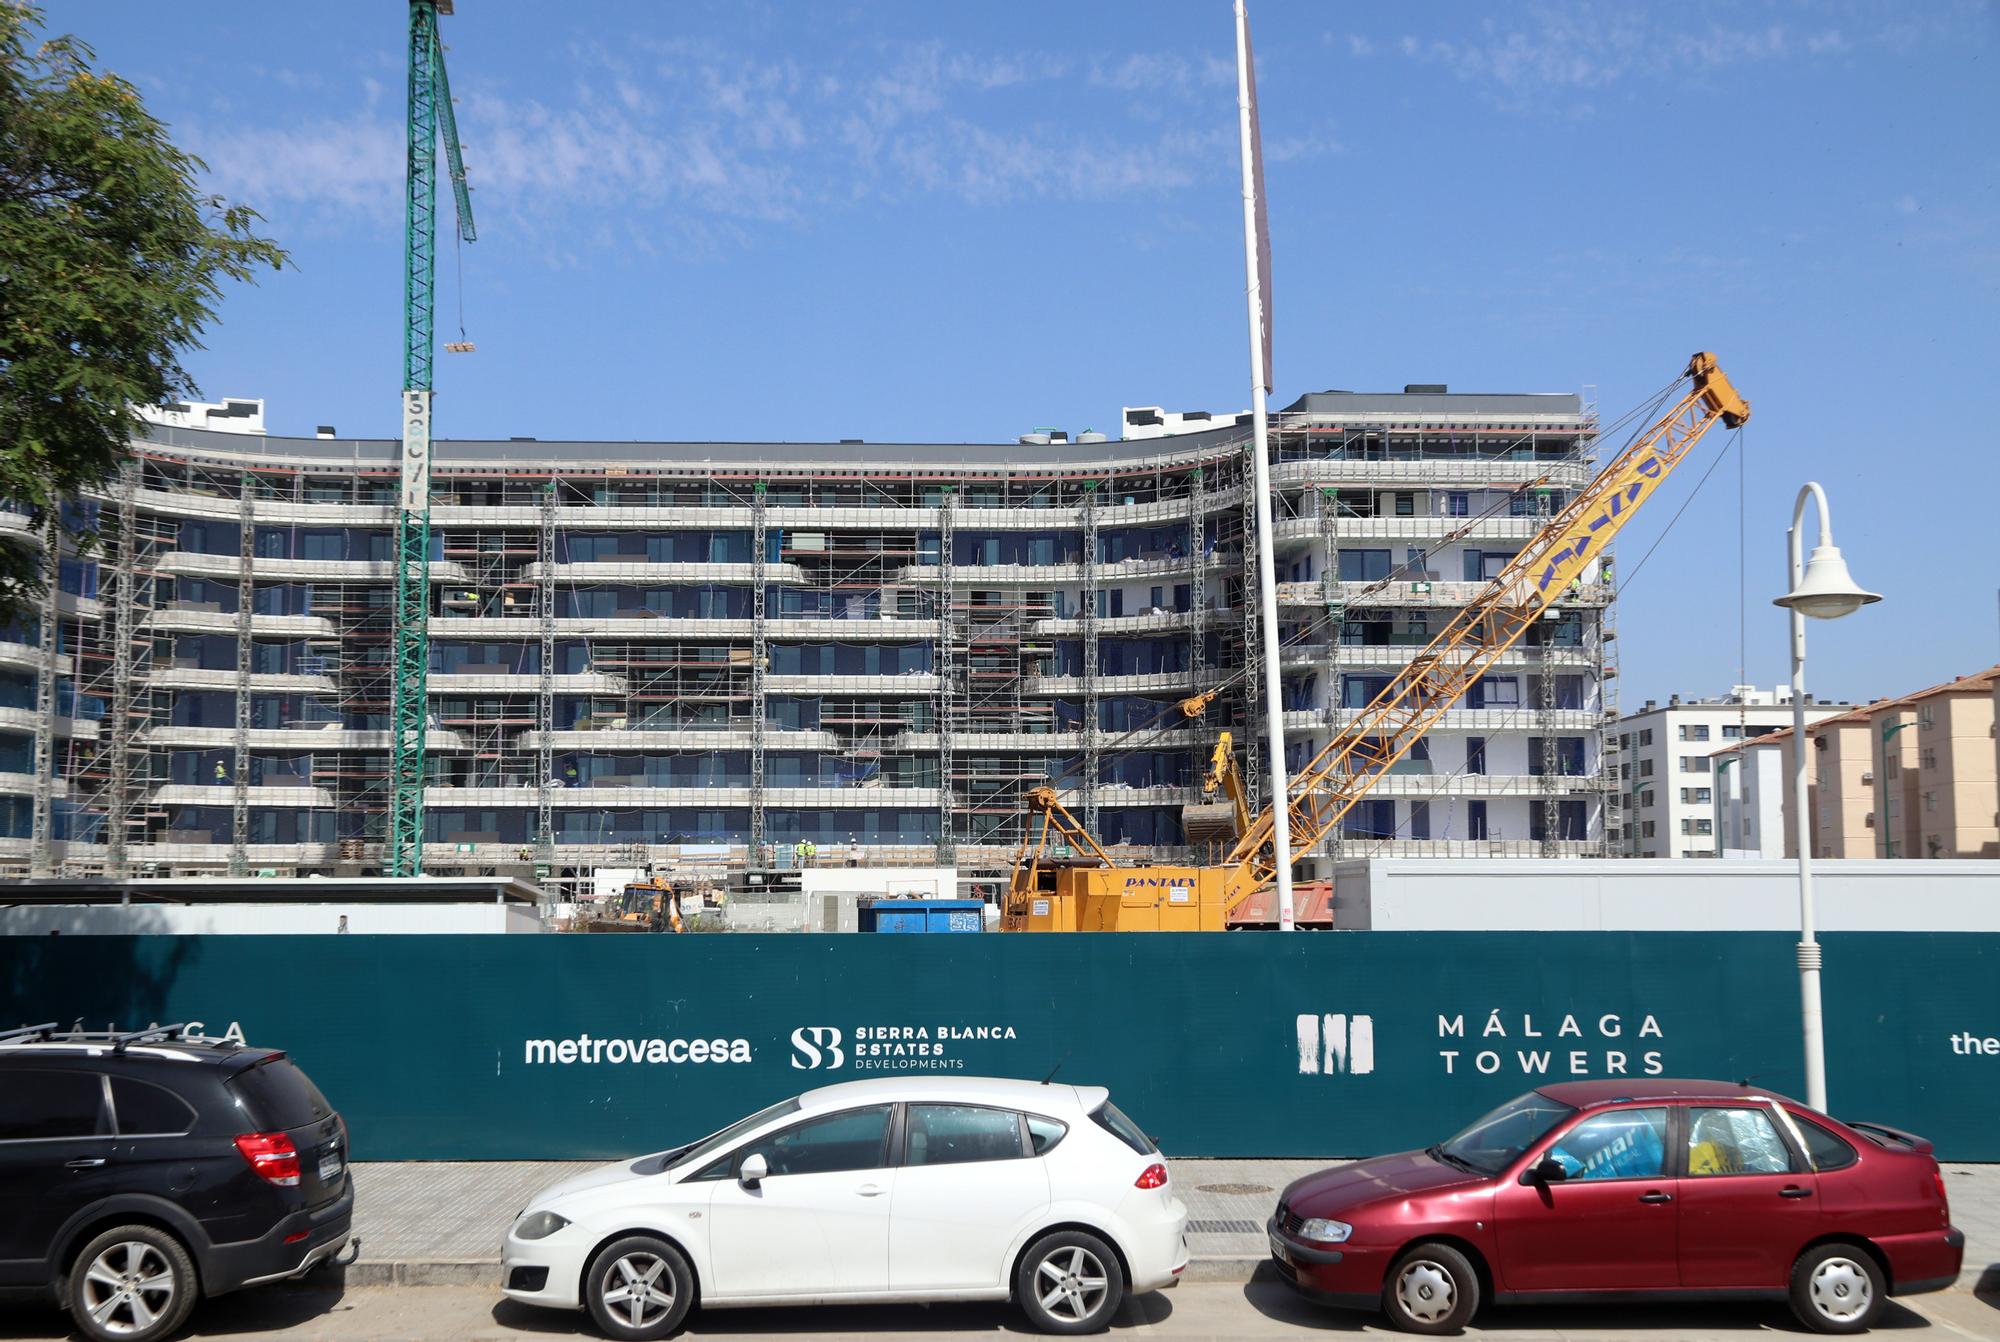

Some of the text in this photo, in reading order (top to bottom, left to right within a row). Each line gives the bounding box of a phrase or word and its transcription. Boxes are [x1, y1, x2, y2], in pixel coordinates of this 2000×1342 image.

[1125, 877, 1197, 888] PANTAEX
[1439, 1008, 1663, 1038] MÁLAGA
[855, 1026, 1017, 1040] SIERRA BLANCA
[525, 1033, 752, 1064] metrovacesa
[855, 1043, 944, 1056] ESTATES
[1950, 1031, 2000, 1055] the
[855, 1059, 964, 1069] DEVELOPMENTS
[1439, 1050, 1663, 1075] TOWERS
